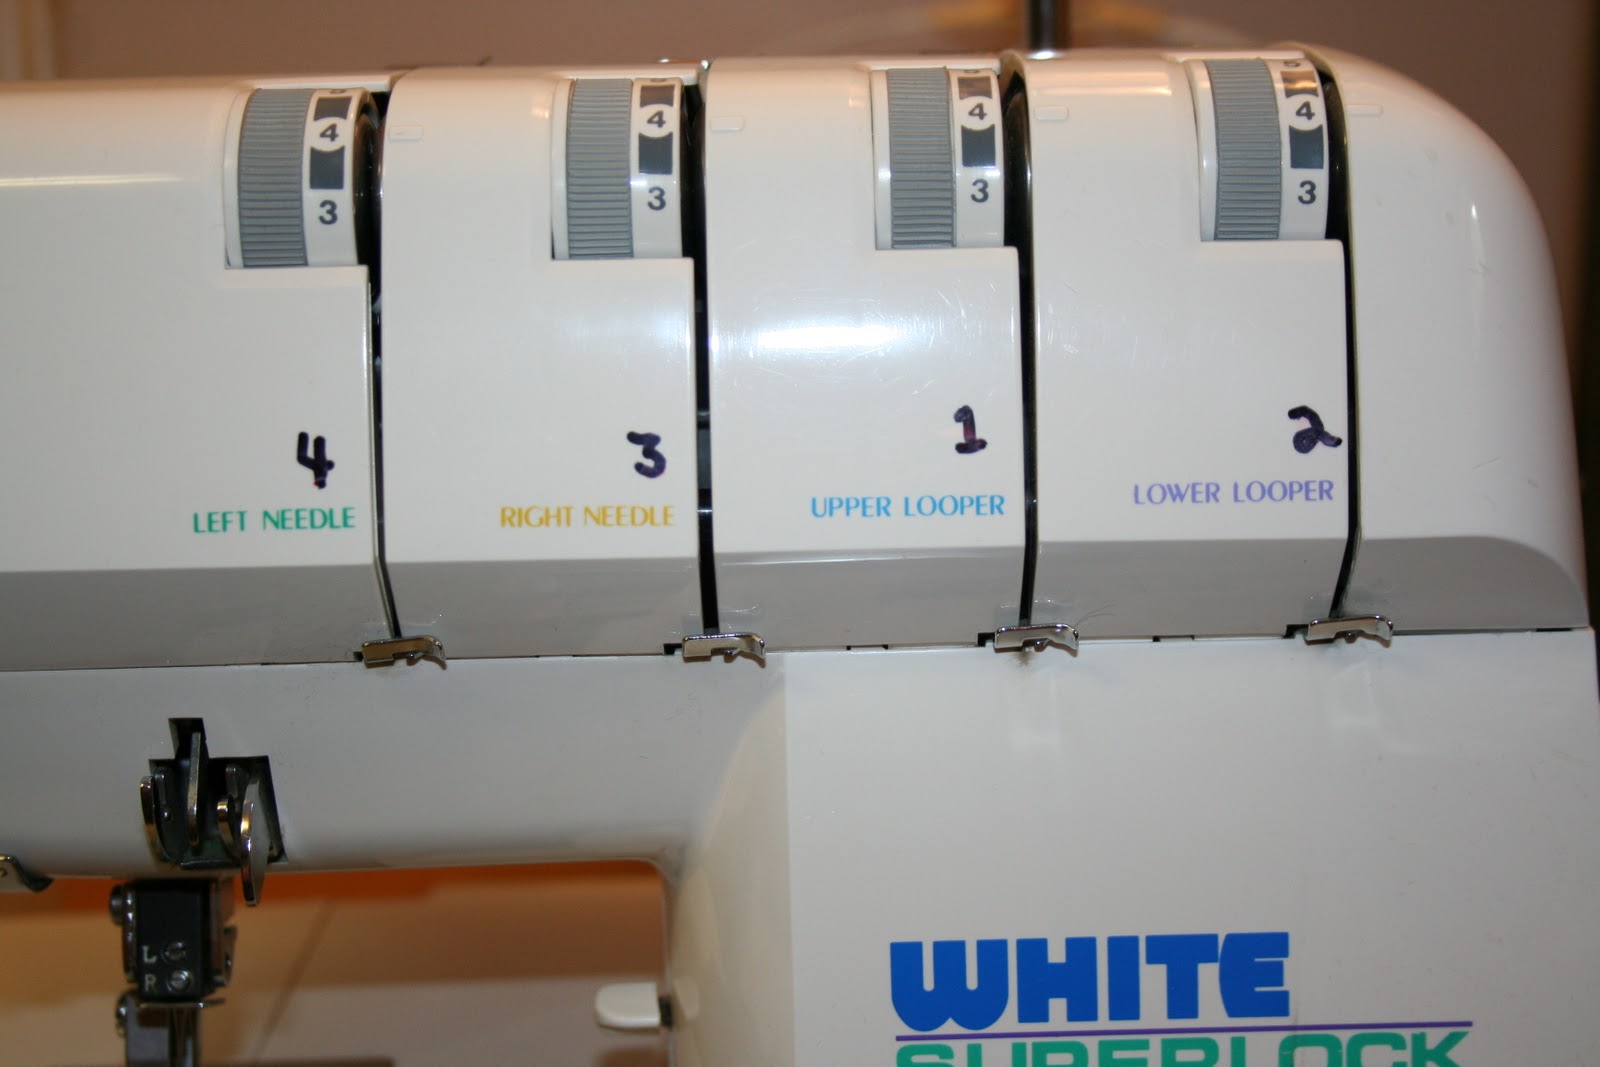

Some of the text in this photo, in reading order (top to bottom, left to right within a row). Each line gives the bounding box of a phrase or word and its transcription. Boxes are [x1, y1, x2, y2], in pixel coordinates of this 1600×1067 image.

[647, 110, 666, 128] 4
[968, 103, 987, 120] 4
[1295, 101, 1315, 121] 4
[319, 123, 339, 142] 4
[647, 186, 666, 211] 3
[970, 178, 989, 203] 3
[1297, 180, 1317, 205] 3
[319, 200, 338, 225] 3
[953, 405, 988, 454] 1
[1287, 405, 1343, 454] 2
[296, 431, 335, 490] 4
[626, 431, 667, 479] 3
[1133, 479, 1335, 505] LOWER LOOPER
[500, 504, 675, 528] RIGHT NEEDLE
[811, 494, 1005, 518] UPPER LOOPER
[193, 506, 356, 533] LEFT NEEDLE
[142, 945, 157, 963] L
[145, 973, 156, 992] R
[890, 931, 1290, 1032] WHITE
